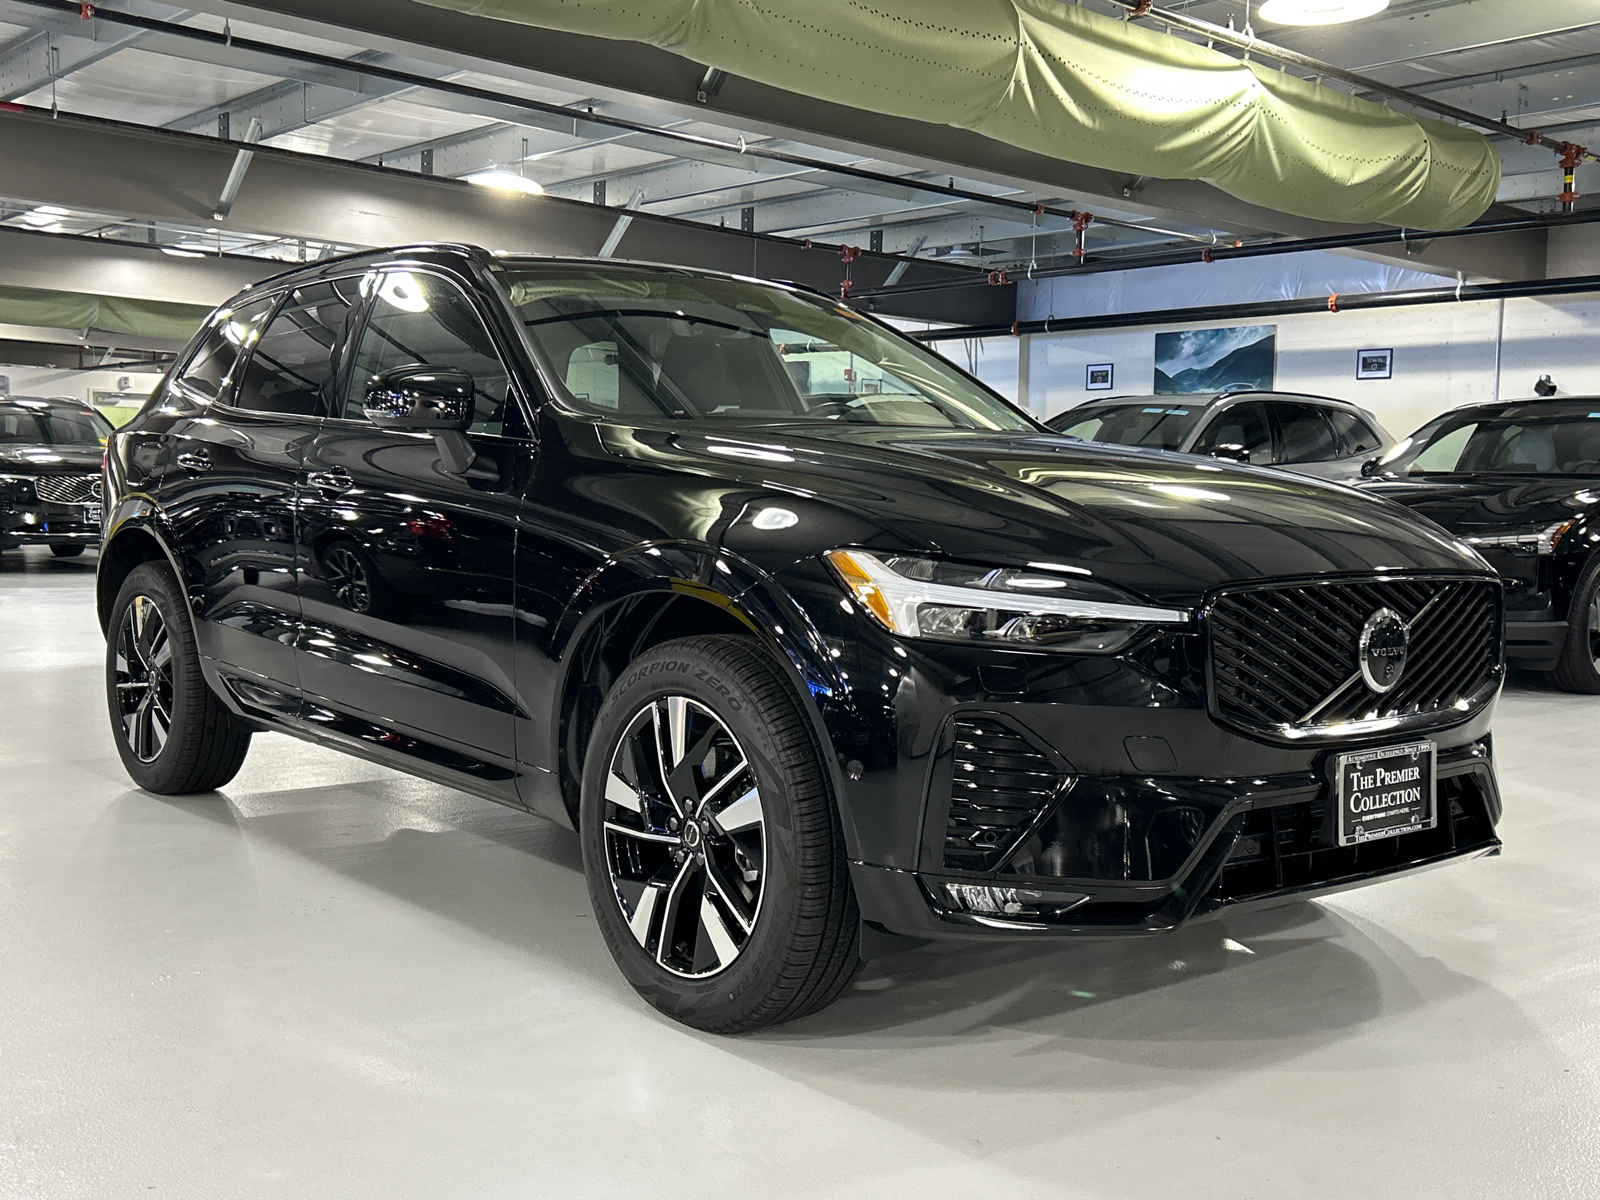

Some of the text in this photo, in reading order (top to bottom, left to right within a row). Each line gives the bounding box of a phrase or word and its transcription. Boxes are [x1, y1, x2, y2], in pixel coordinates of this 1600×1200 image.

[1371, 646, 1405, 657] VOLVO
[611, 660, 742, 712] SCORPION ZERO
[1350, 767, 1420, 791] THE PREMIER
[1350, 787, 1421, 813] COLLECTION
